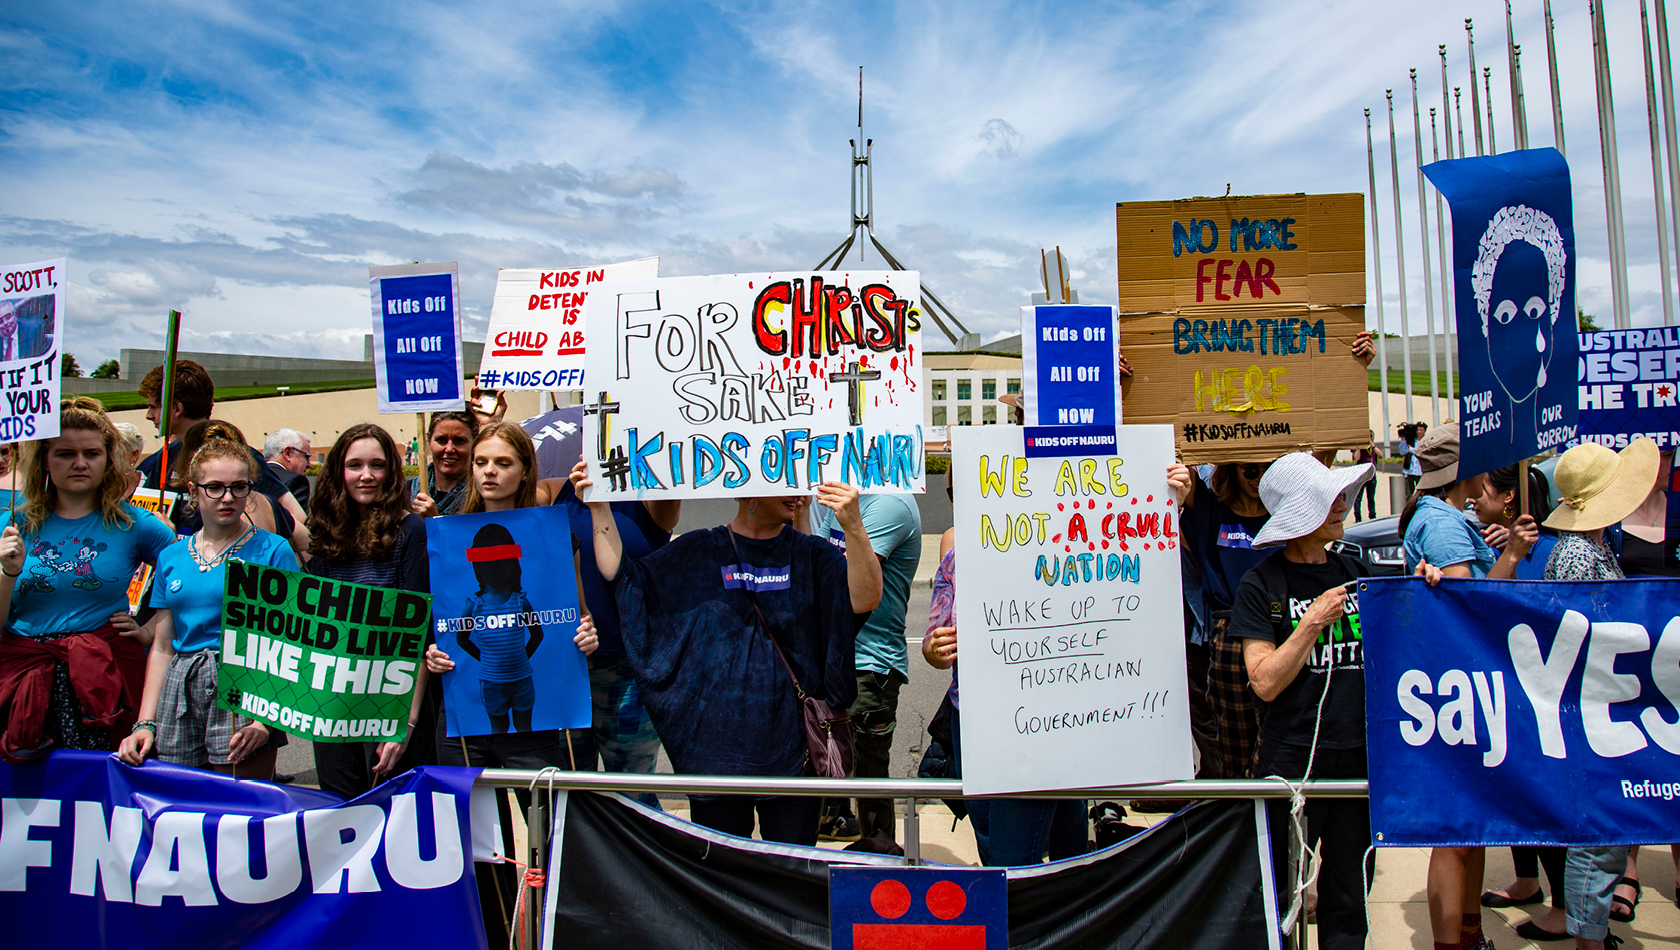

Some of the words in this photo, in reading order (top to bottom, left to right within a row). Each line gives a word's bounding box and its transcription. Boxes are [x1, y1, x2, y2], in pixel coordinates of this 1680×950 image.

[1172, 217, 1219, 257] NO
[1230, 216, 1298, 253] MORE
[3, 266, 58, 293] SCOTT,
[540, 270, 581, 289] KIDS
[586, 269, 605, 285] IN
[1196, 257, 1281, 303] FEAR
[387, 298, 421, 315] Kids
[424, 296, 446, 313] Off
[528, 291, 588, 310] DETEN
[563, 309, 580, 325] IS
[397, 337, 416, 354] All
[420, 336, 442, 352] Off
[494, 331, 548, 349] CHILD
[617, 290, 750, 380] FOR
[1042, 327, 1078, 342] Kids
[1083, 327, 1106, 342] Off
[1172, 317, 1255, 355] BRING
[1256, 317, 1326, 356] THEM
[30, 349, 57, 385] IT
[1050, 366, 1073, 382] All
[1077, 366, 1100, 382] Off
[6, 388, 52, 416] YOUR
[405, 378, 438, 395] NOW
[672, 370, 814, 425] SAKE
[1193, 365, 1291, 415] HERE
[1463, 390, 1493, 414] YOUR
[1631, 381, 1680, 408] TR
[1058, 408, 1095, 424] NOW
[1464, 410, 1501, 438] TEARS
[1541, 404, 1563, 425] OUR
[1536, 424, 1578, 450] SORROW
[600, 427, 750, 492] #KIDS
[760, 428, 839, 490] OFF
[840, 424, 923, 490] NAURU
[979, 454, 1032, 498] WE
[1053, 457, 1129, 498] ARE
[979, 512, 1051, 552] NOT
[1068, 513, 1088, 543] A
[1101, 511, 1178, 543] CRUEL
[1035, 553, 1140, 587] NATION
[227, 561, 289, 605] NO
[297, 576, 429, 629] CHILD
[983, 597, 1052, 626] WAKE
[1071, 596, 1096, 620] UP
[1111, 595, 1140, 614] TO
[226, 601, 339, 650] SHOULD
[346, 628, 423, 658] LIVE
[990, 629, 1108, 661] YOURSELF
[222, 629, 302, 683] LIKE
[309, 651, 416, 695] THIS
[1020, 658, 1142, 690] AUSTRALIAN
[1397, 669, 1507, 768] say
[1507, 609, 1680, 760] YES
